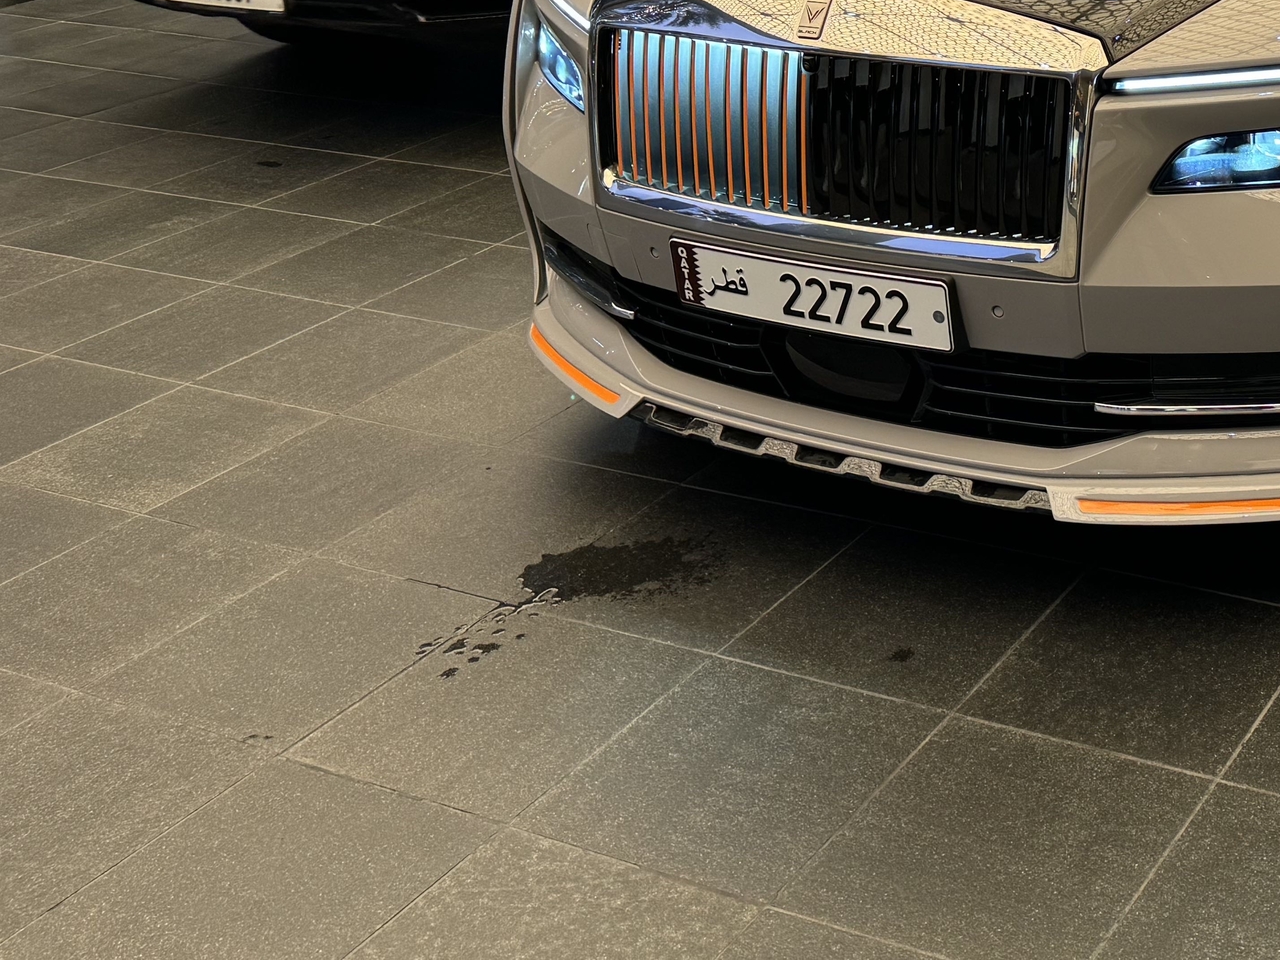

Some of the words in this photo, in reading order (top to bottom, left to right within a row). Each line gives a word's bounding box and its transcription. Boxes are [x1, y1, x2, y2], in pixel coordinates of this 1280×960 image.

[677, 246, 695, 301] QATAR
[703, 266, 749, 297] قطر
[779, 273, 913, 337] 22722
